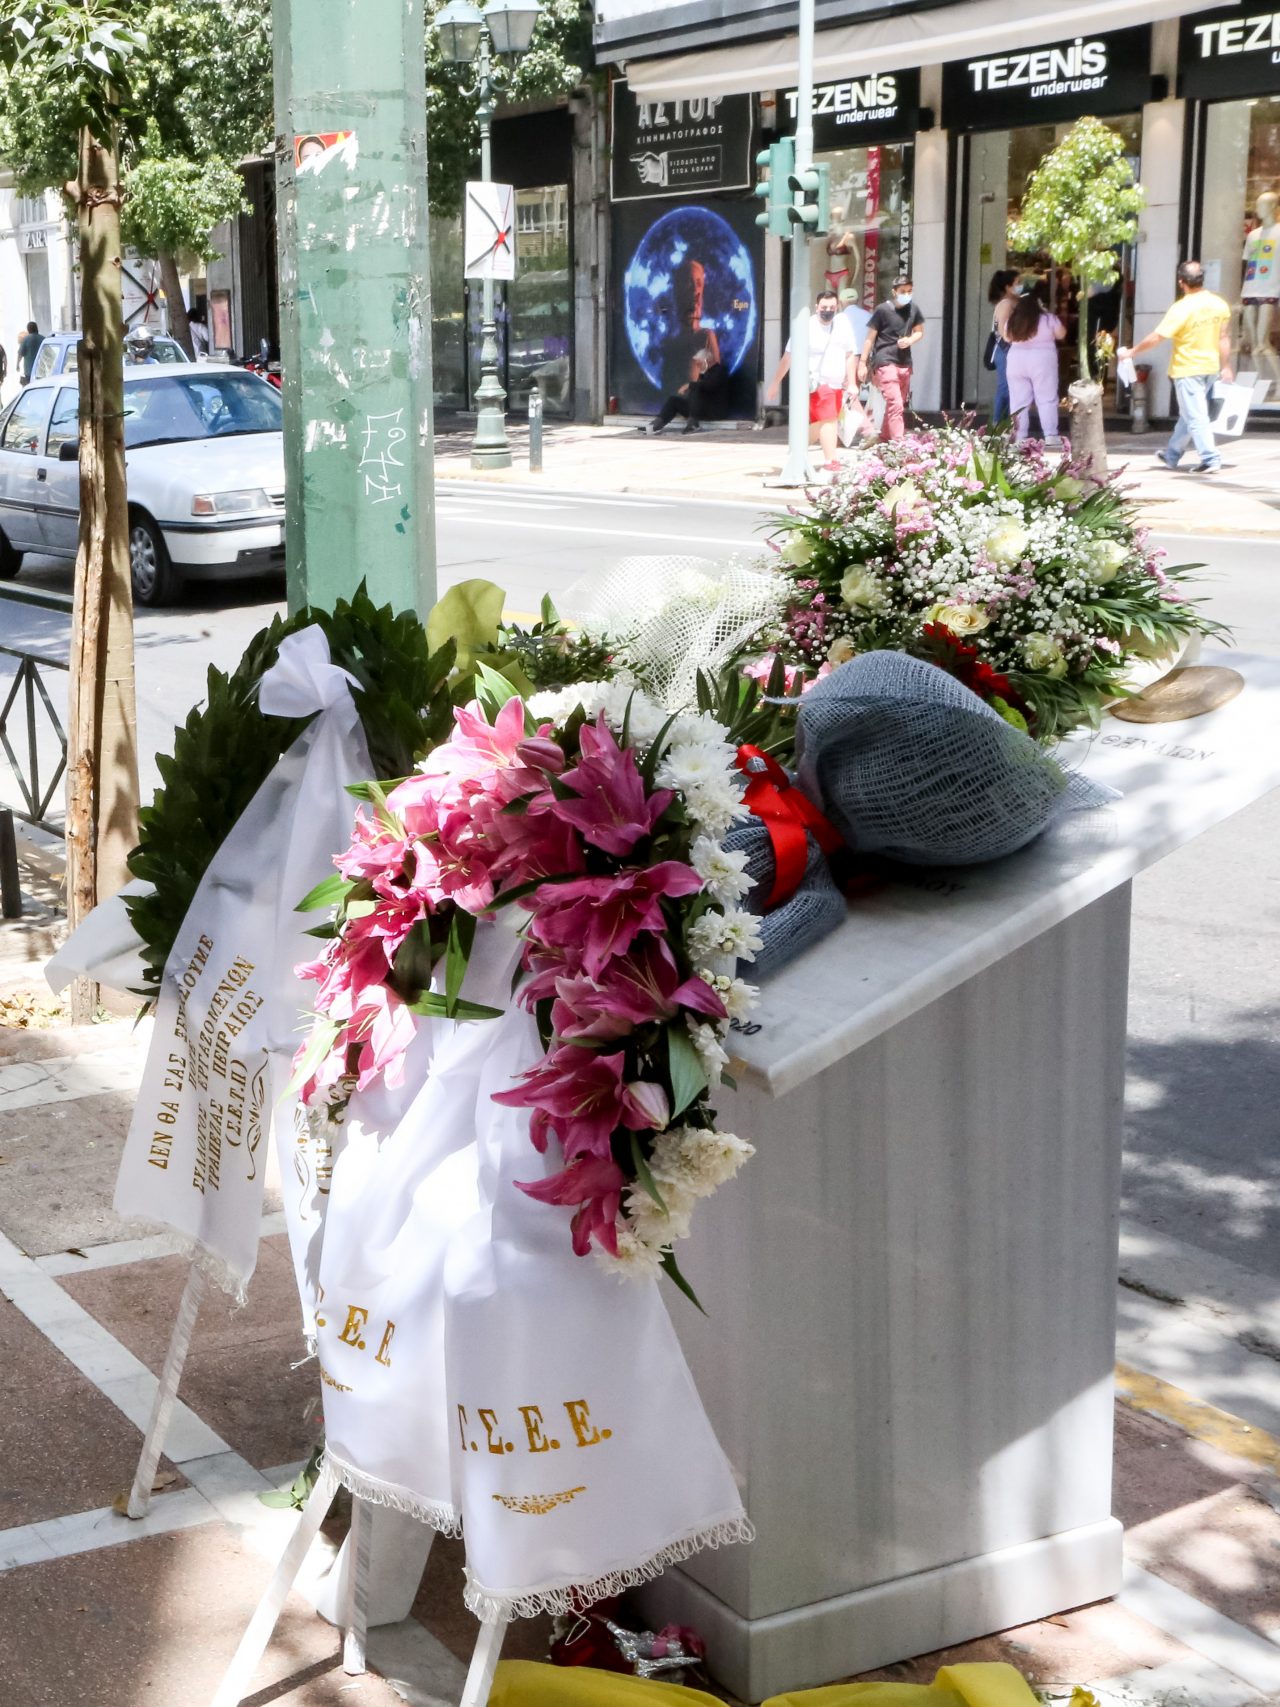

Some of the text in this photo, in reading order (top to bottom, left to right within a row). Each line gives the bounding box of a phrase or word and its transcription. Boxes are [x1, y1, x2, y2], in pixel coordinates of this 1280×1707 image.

[1031, 76, 1108, 98] underwear
[836, 106, 898, 124] underwear
[637, 125, 723, 144] ΚΙΝΗΜΑΤΟΓΡΑΦΟΣ
[26, 230, 48, 248] ZARA
[900, 200, 910, 276] LAYBOY
[164, 1053, 187, 1092] ΣΑΣ
[192, 955, 256, 1195] ΣΥΛΛΟΓΟΣ ΕΡΓΑΖΟΜΕΝΩΝ
[208, 990, 264, 1191] ΤΡΑΠΕΖΑΣ ΠΕΙΡΑΙΩΣ
[157, 1101, 179, 1125] ΘΑ
[148, 1130, 174, 1170] ΔΕΝ
